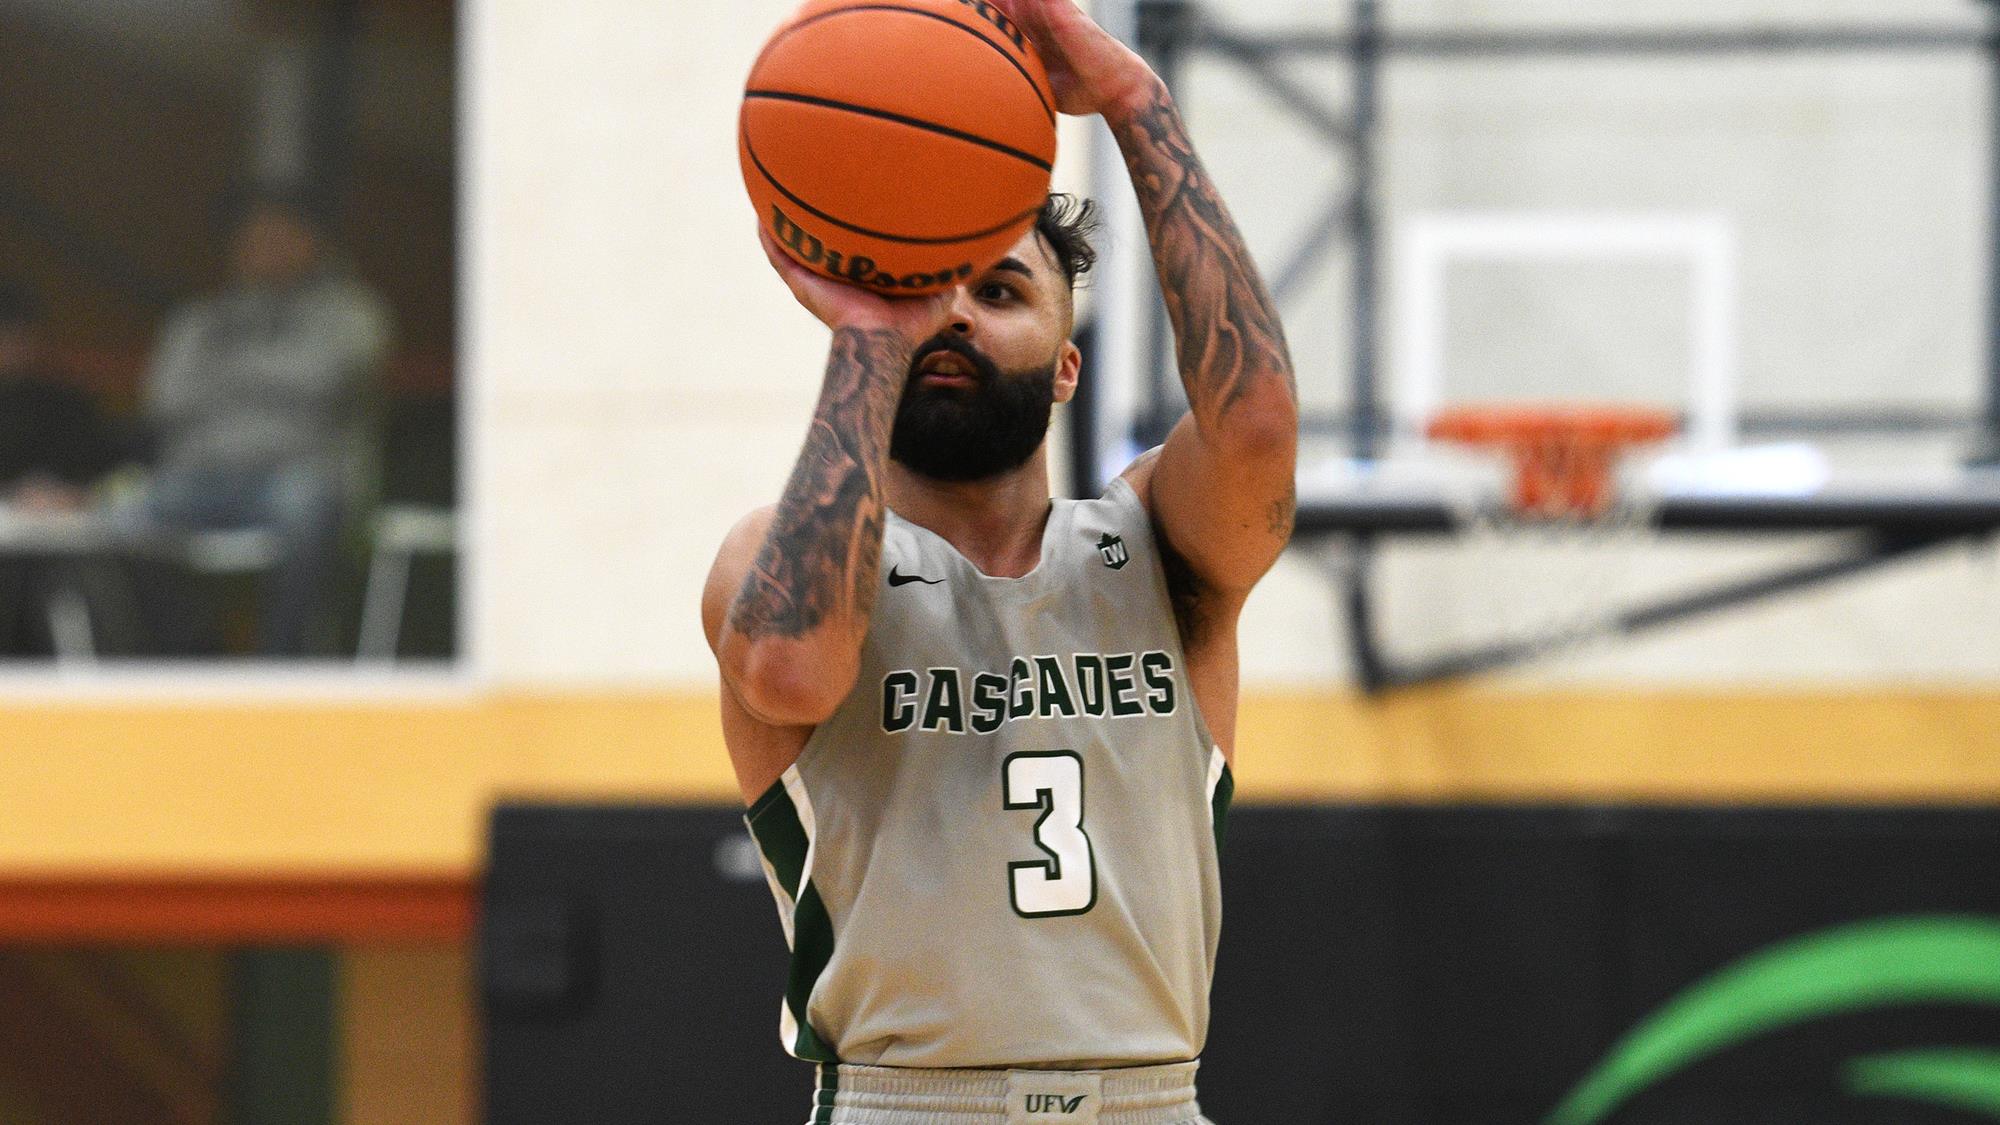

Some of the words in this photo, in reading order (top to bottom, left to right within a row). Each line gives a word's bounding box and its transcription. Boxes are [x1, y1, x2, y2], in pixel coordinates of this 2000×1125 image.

[771, 203, 973, 289] Wilson
[881, 651, 1178, 735] CASCADES
[1002, 749, 1097, 919] 3
[1025, 1094, 1088, 1114] UFV
